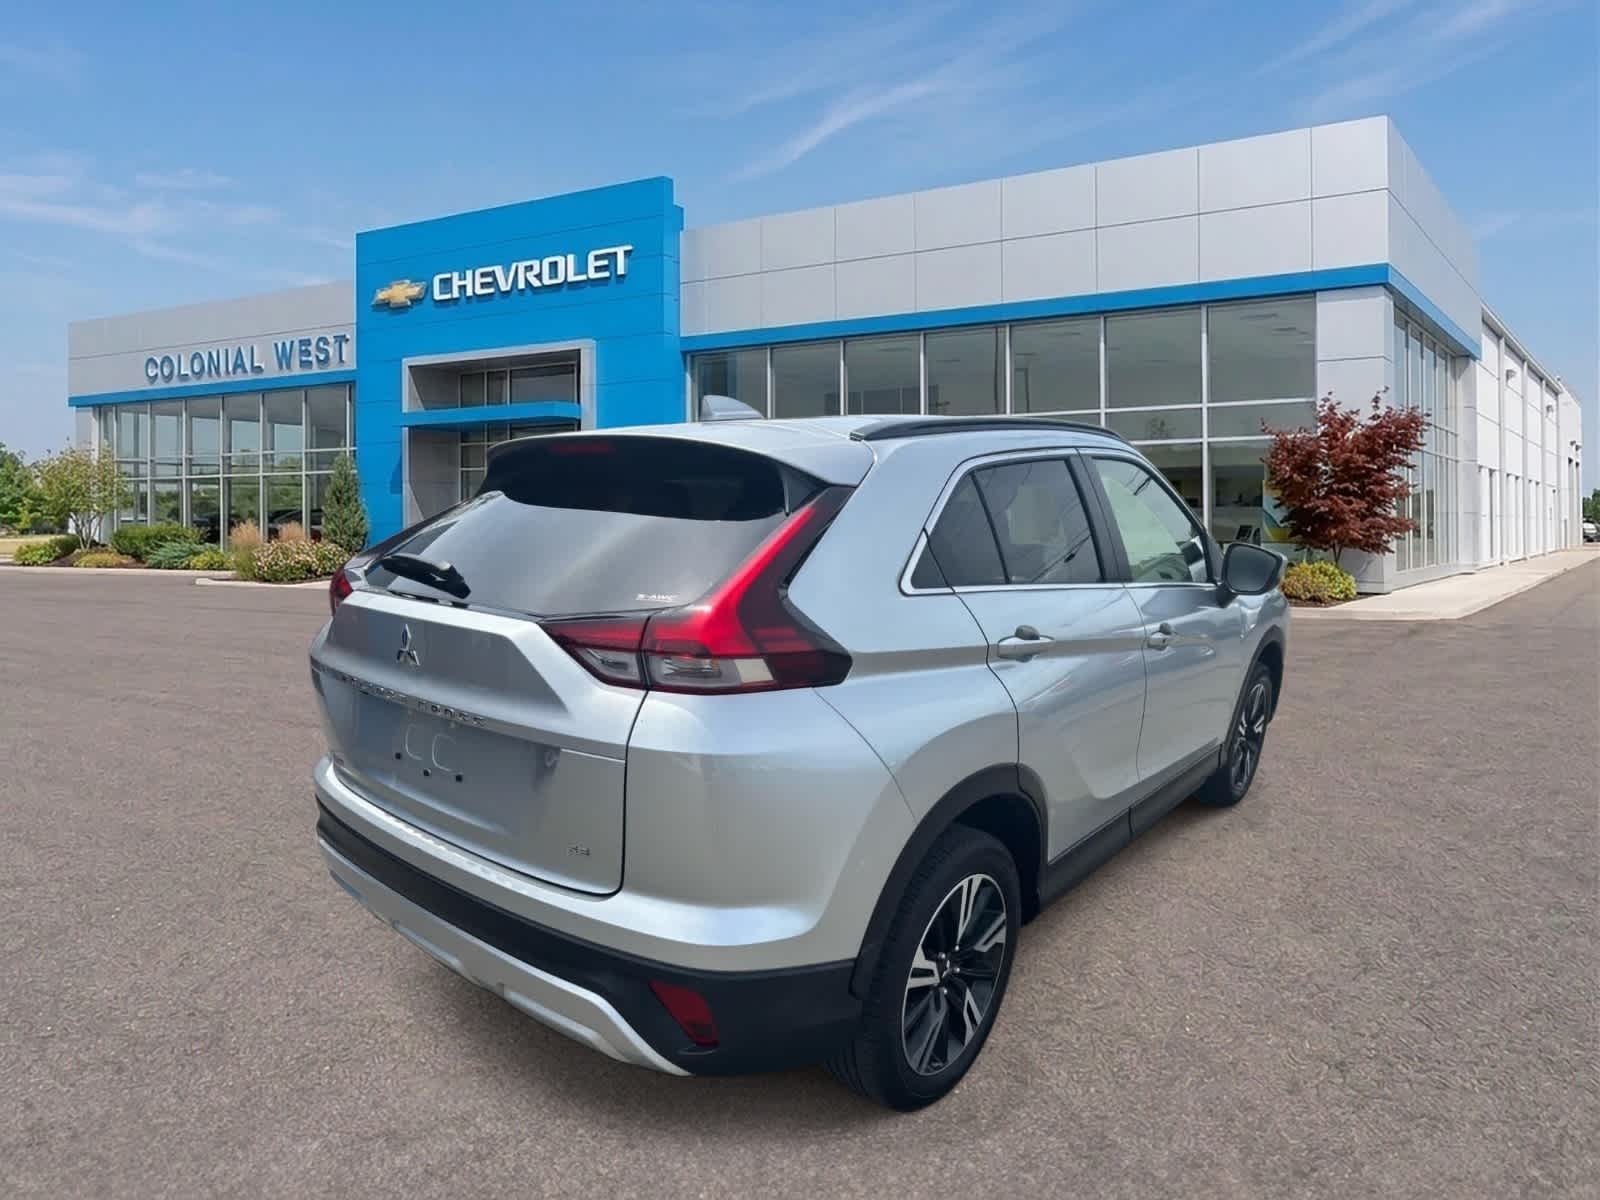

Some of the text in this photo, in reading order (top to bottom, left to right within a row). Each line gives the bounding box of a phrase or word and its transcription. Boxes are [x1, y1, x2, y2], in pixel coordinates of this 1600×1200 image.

[432, 245, 633, 301] CHEVROLET
[145, 333, 349, 384] COLONIAL WEST
